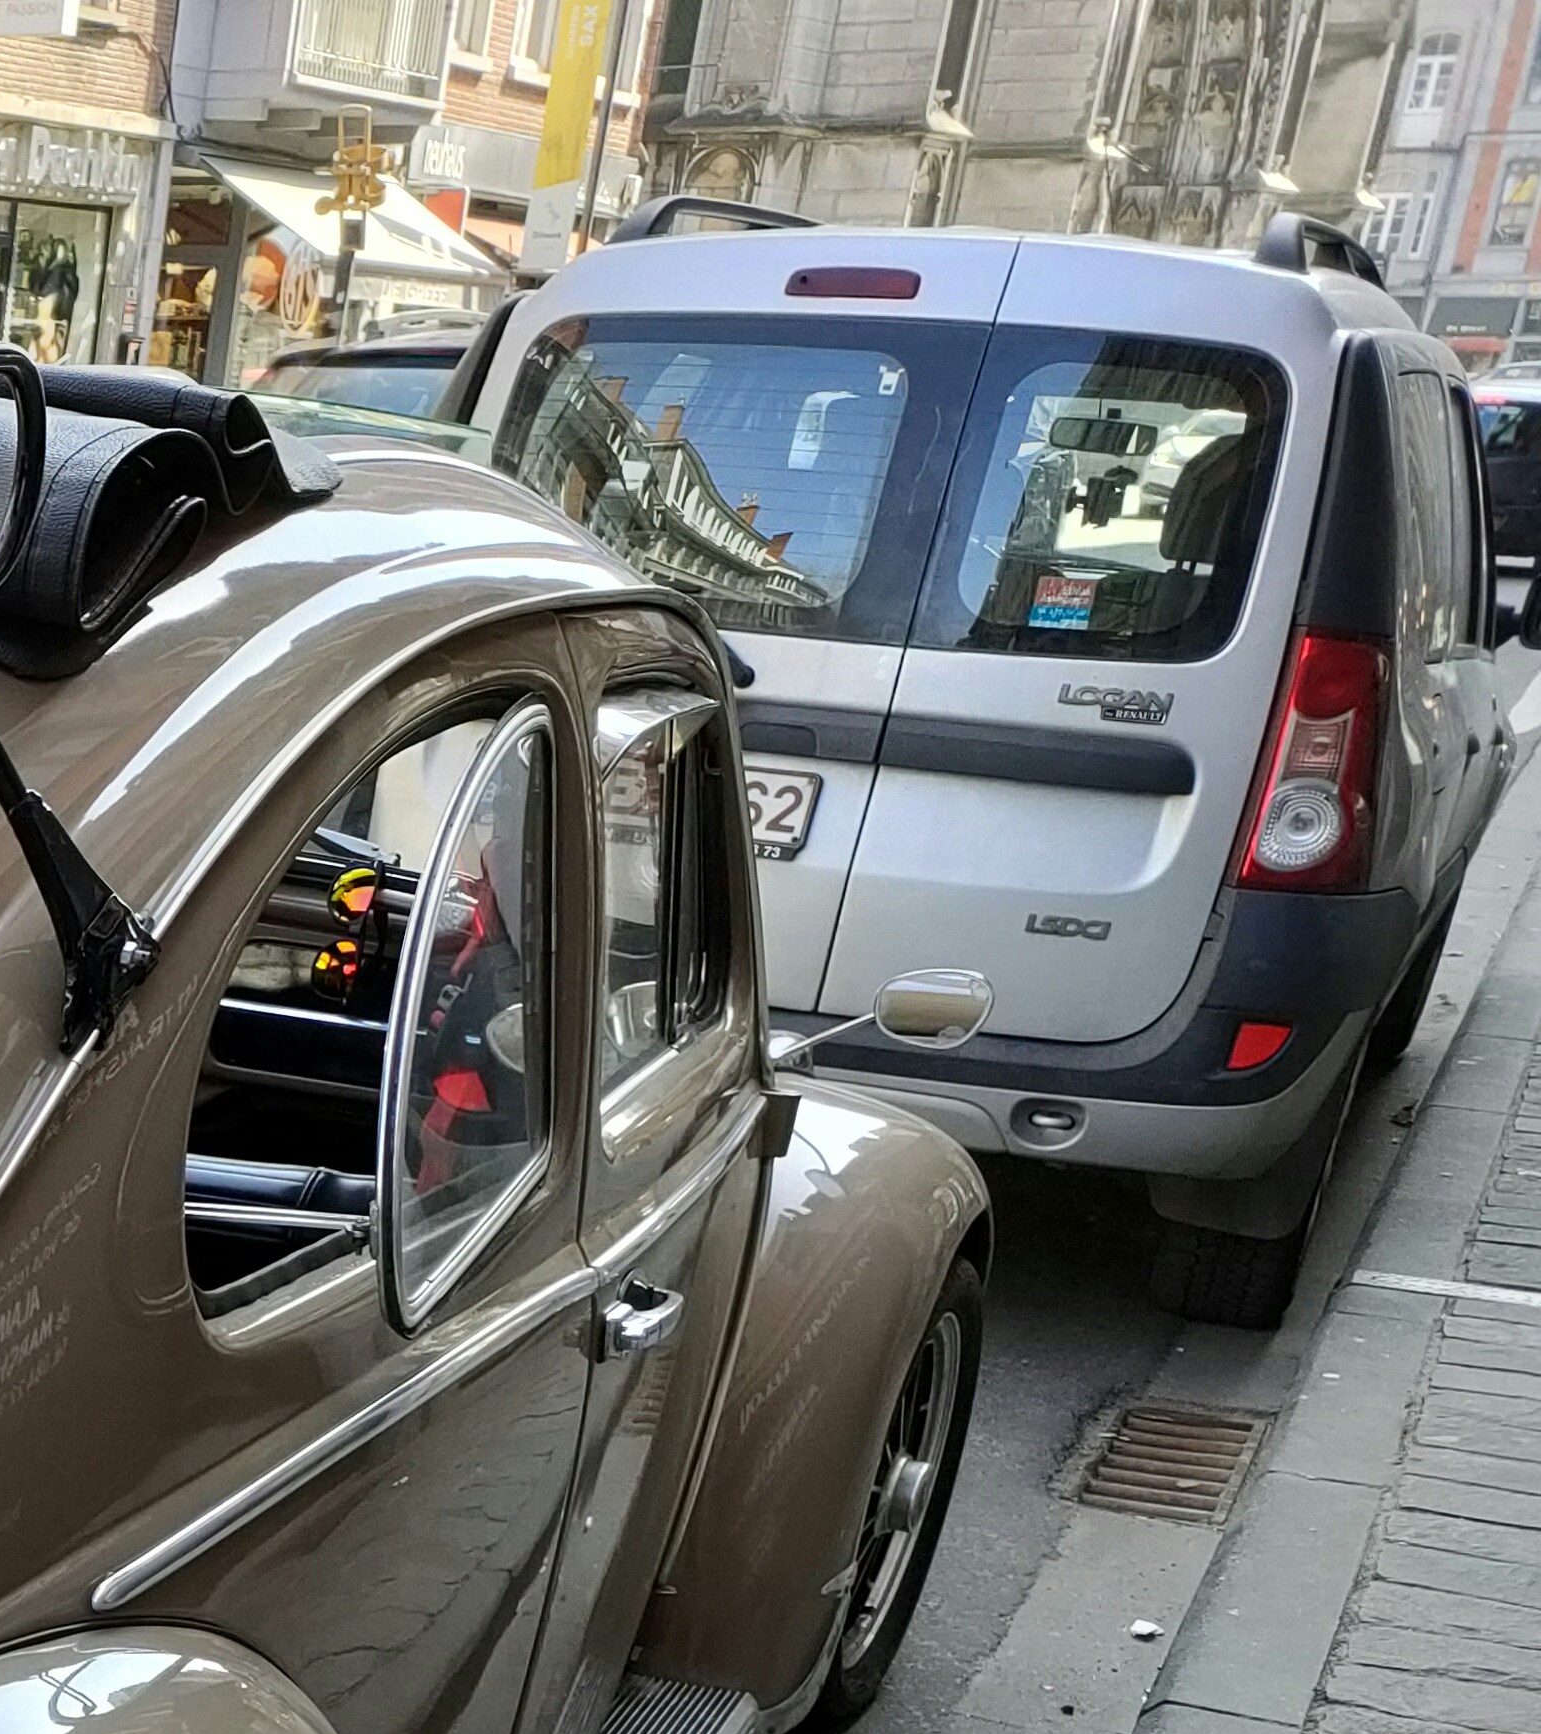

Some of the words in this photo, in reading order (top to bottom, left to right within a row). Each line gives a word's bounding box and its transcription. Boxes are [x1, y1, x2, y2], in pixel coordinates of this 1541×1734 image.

[423, 128, 465, 179] neuhaus
[1058, 683, 1174, 711] LOGAN
[1115, 710, 1164, 722] RENAULT
